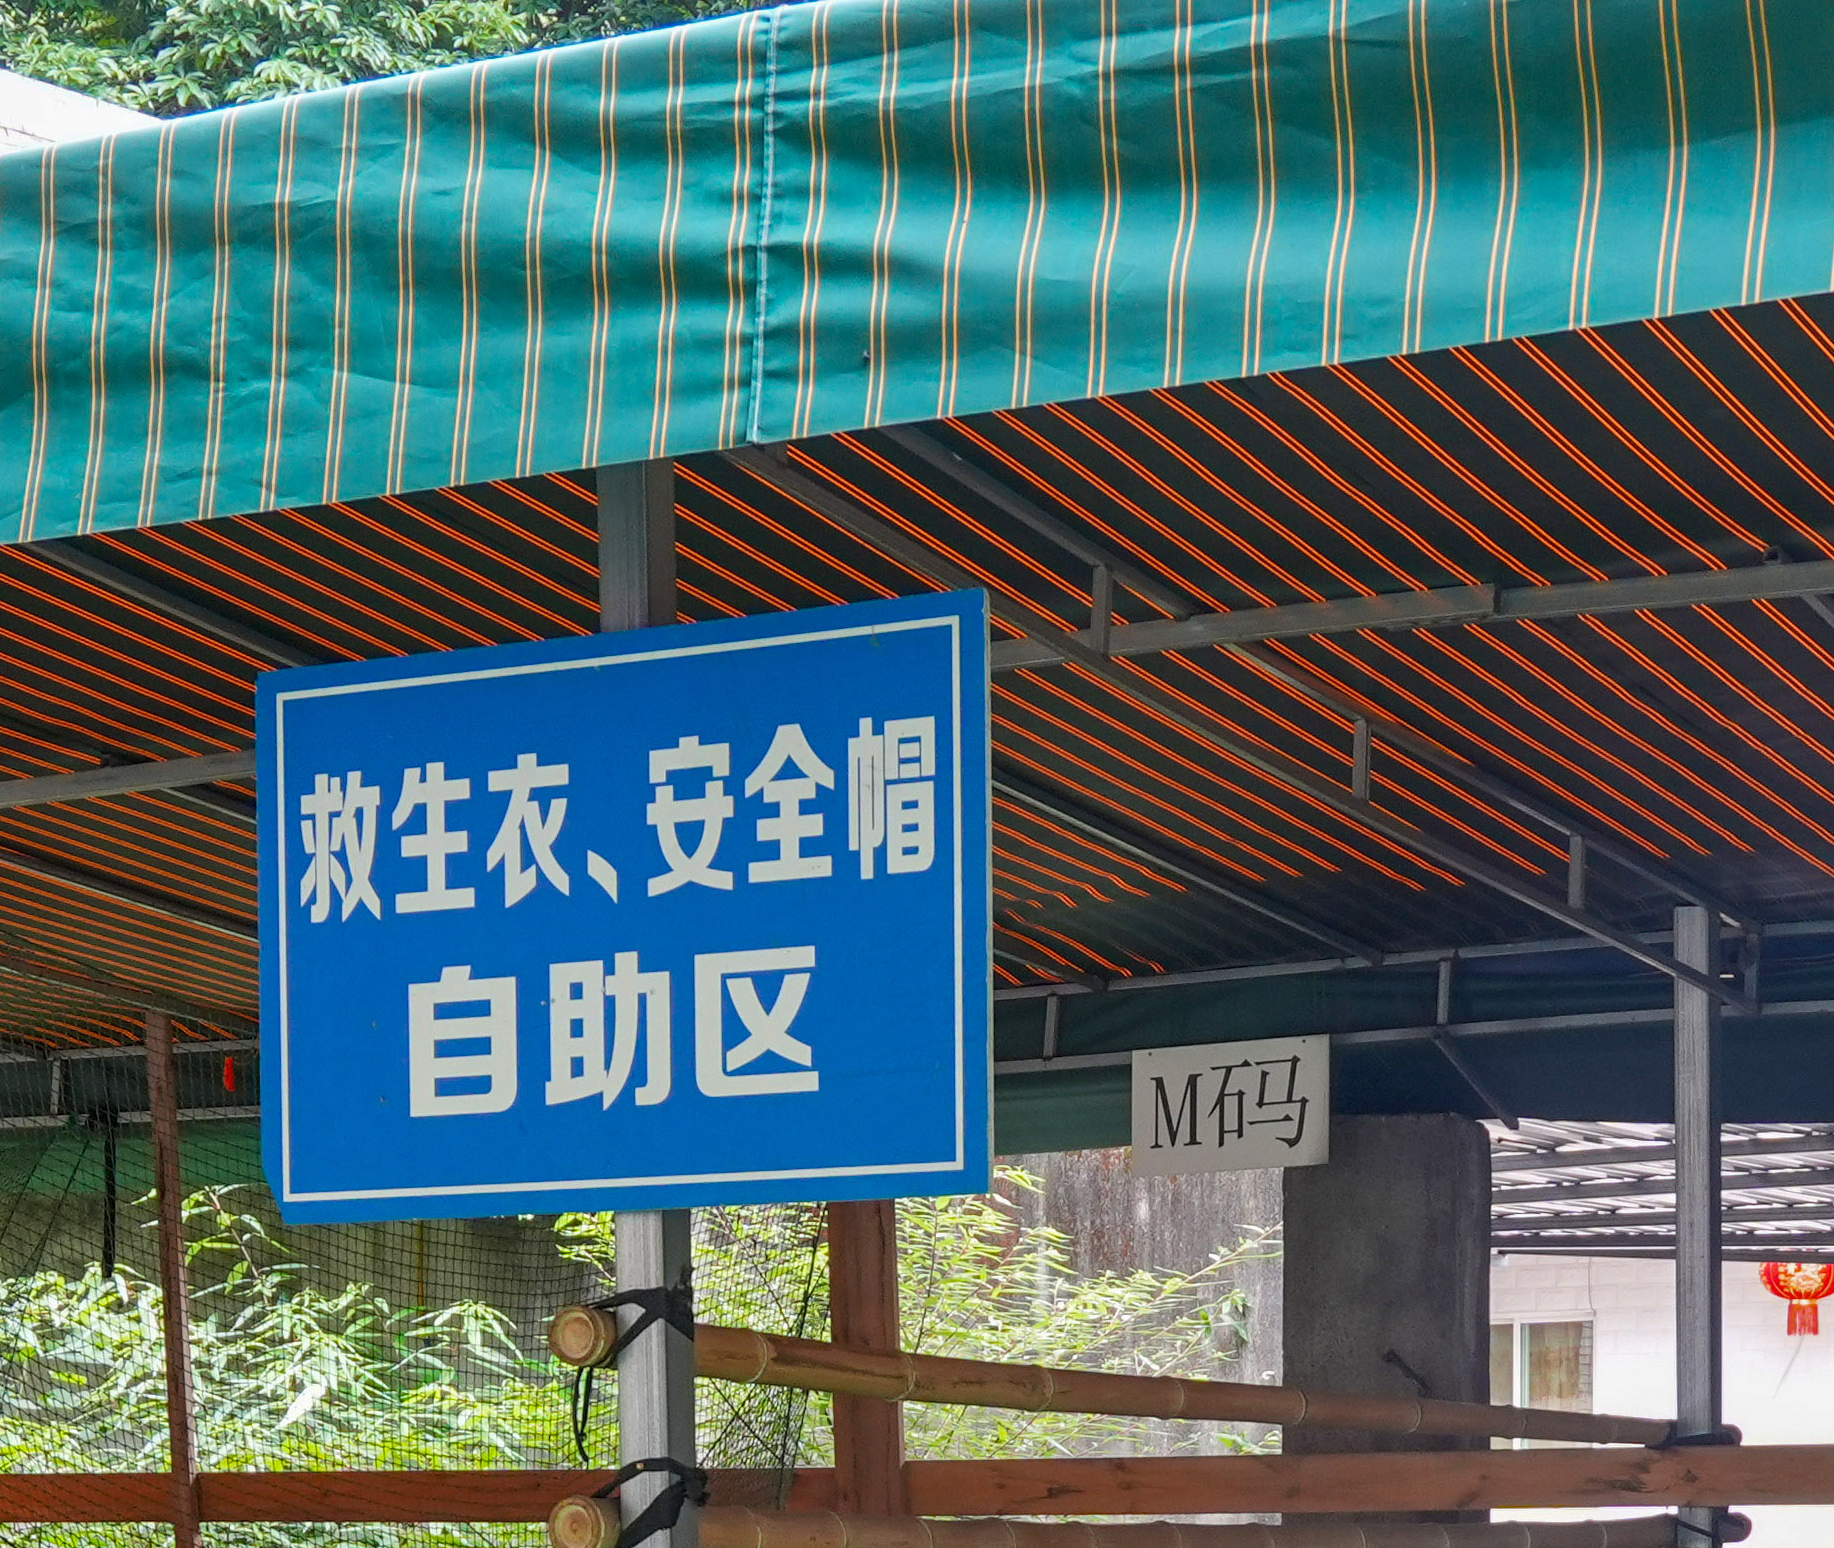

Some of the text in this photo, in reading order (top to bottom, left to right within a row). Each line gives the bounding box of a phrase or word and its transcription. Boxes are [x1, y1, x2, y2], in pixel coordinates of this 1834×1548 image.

[300, 715, 937, 924] 救生衣、安全帽
[408, 945, 820, 1118] 自助区
[1149, 1054, 1310, 1150] M码
